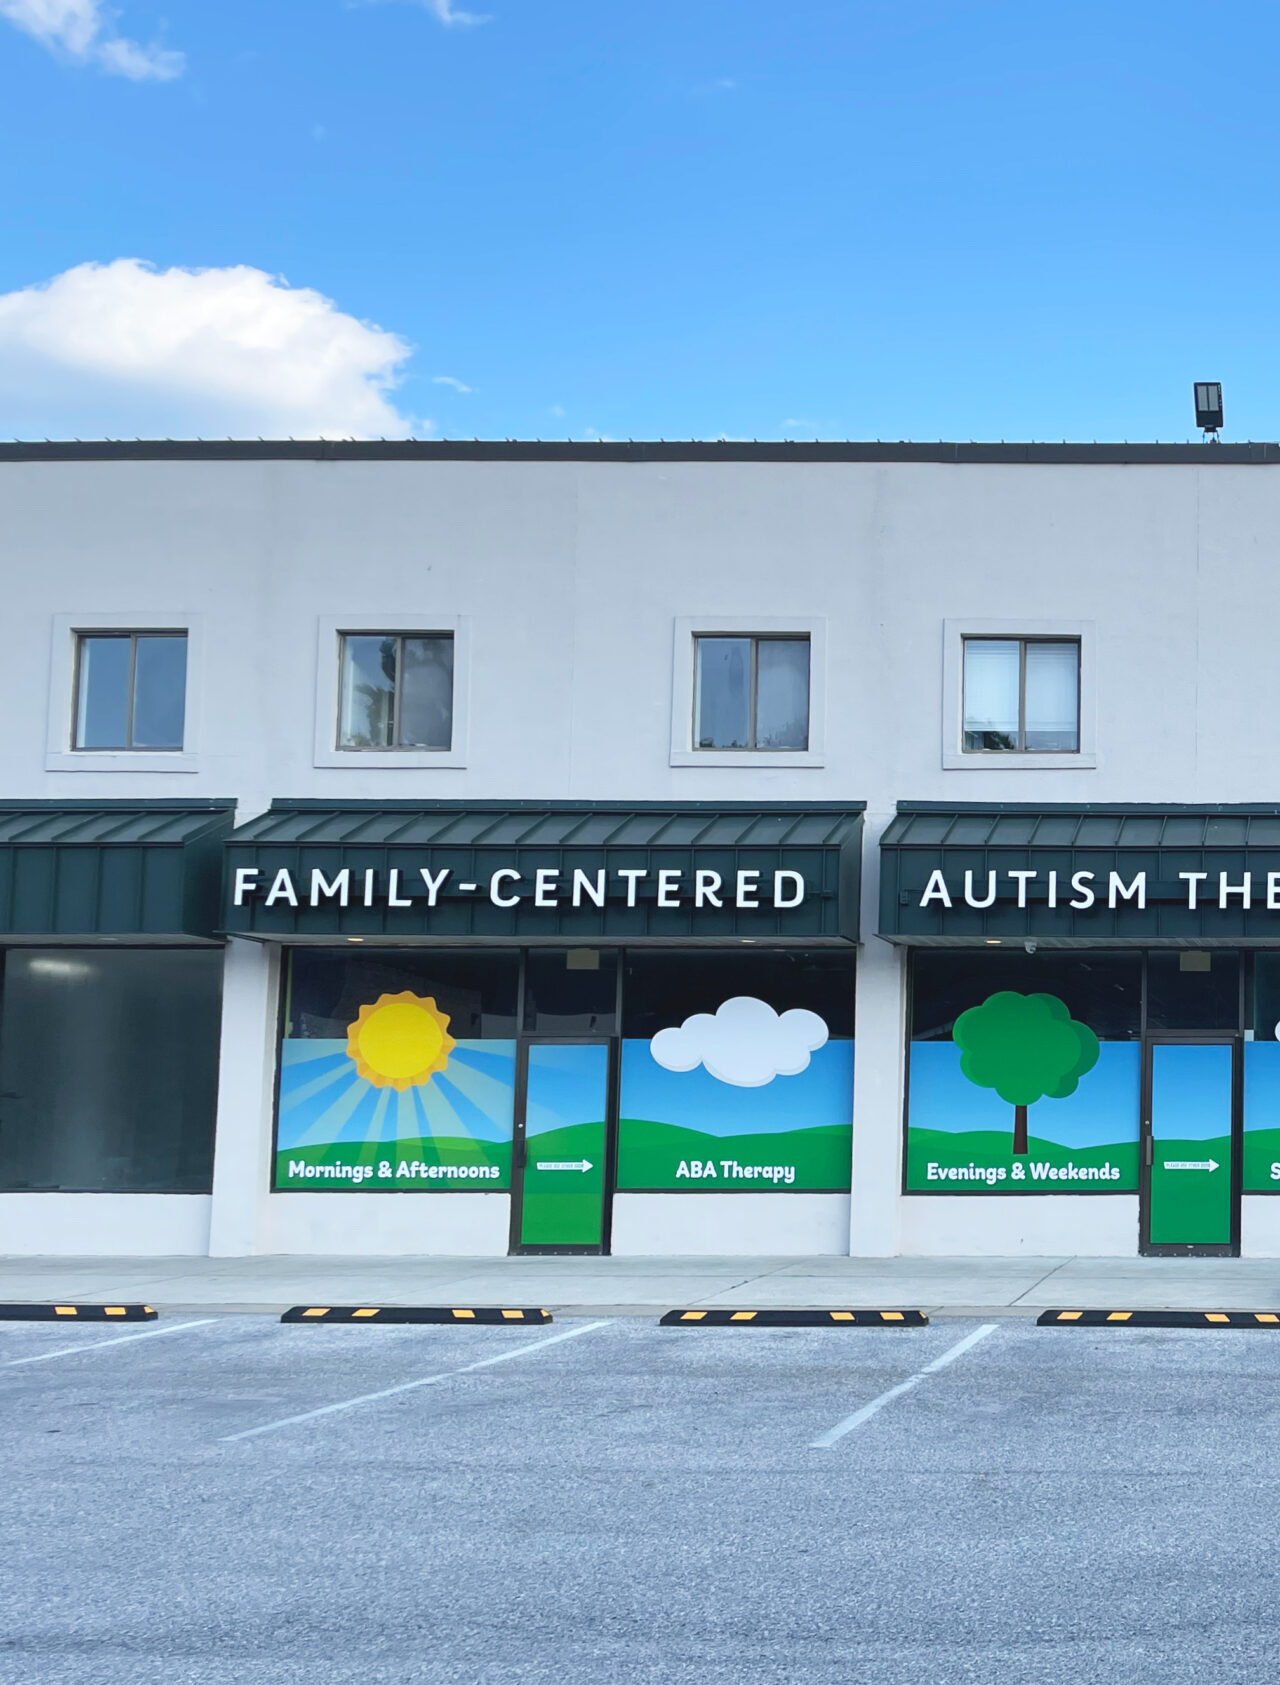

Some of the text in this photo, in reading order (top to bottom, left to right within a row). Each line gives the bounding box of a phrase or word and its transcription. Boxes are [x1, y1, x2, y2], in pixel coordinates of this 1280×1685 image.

[234, 868, 805, 908] FAMILY-CENTERED
[919, 869, 1146, 909] AUTISM
[288, 1160, 500, 1183] Mornings & Afternoons
[675, 1161, 795, 1184] ABA Therapy
[927, 1162, 1120, 1185] Evenings & Weekends
